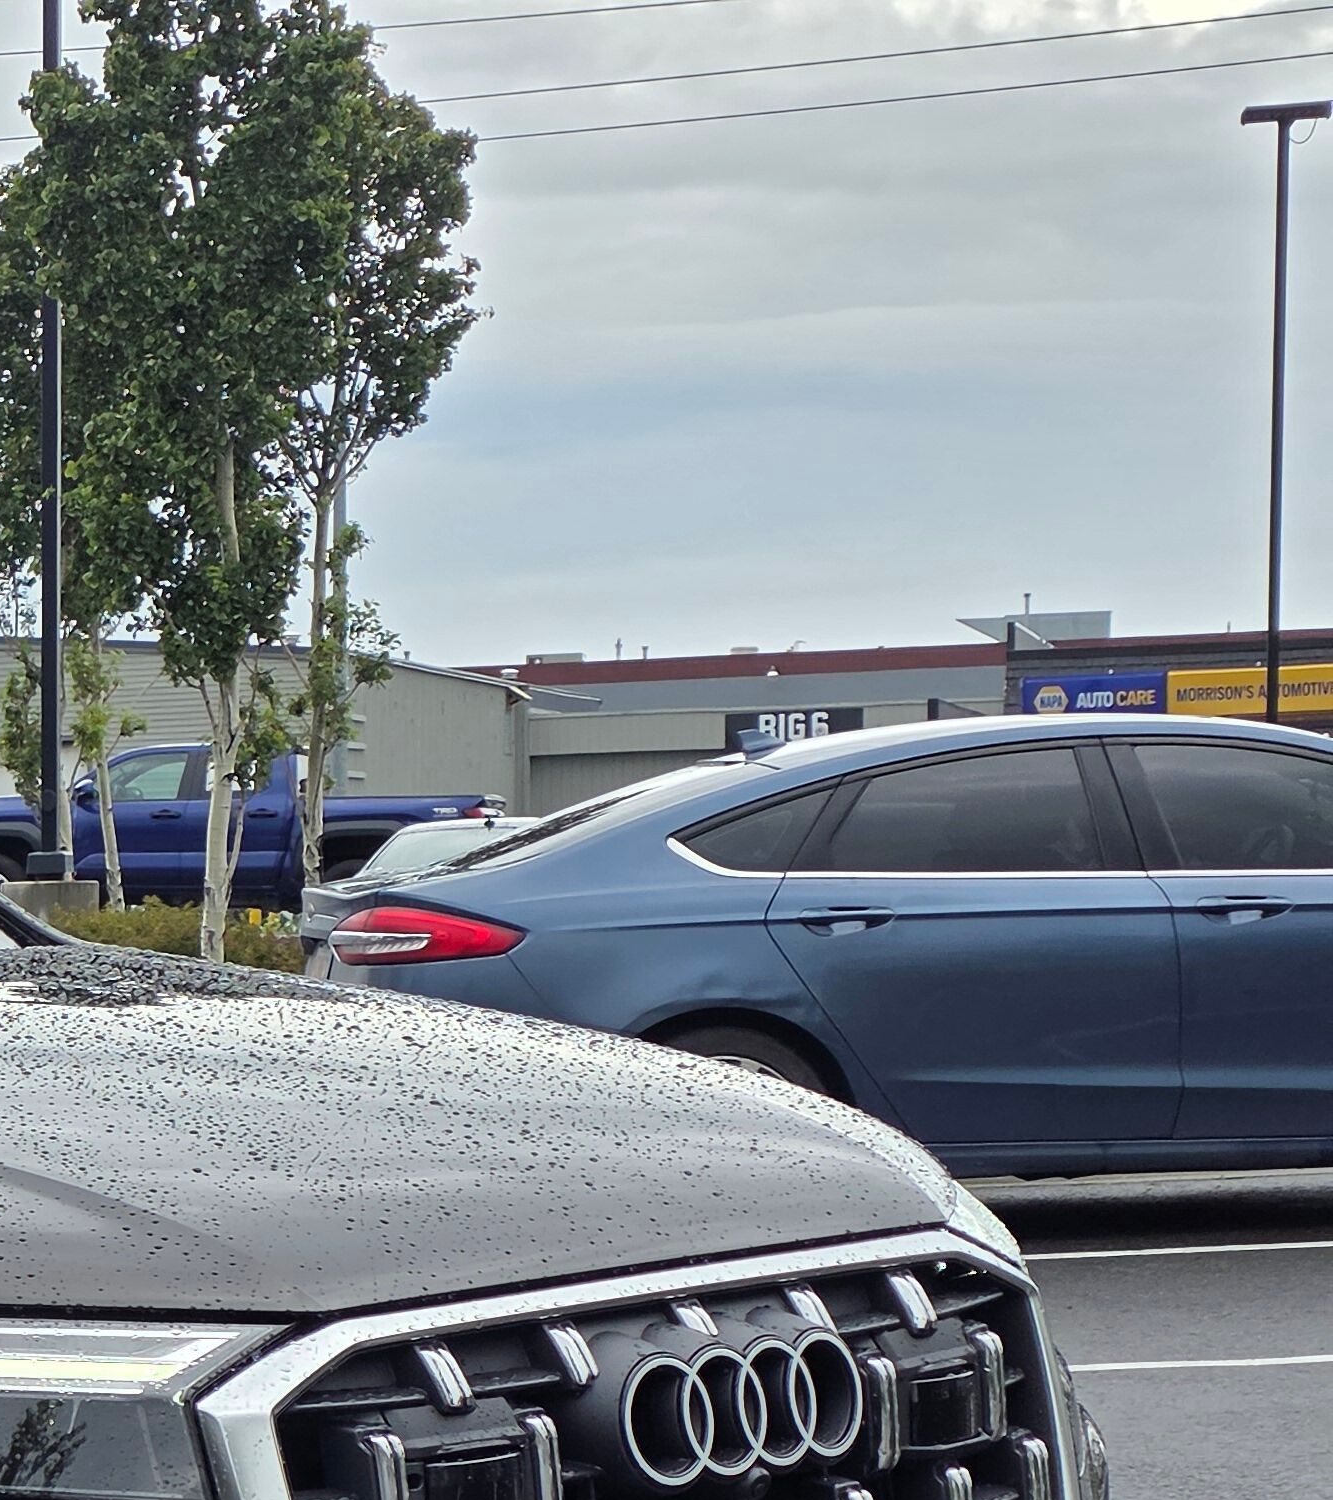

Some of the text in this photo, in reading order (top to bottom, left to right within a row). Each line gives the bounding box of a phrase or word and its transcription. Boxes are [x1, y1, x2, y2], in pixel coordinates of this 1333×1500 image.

[1076, 690, 1114, 709] AUTO
[1116, 689, 1157, 707] CARE
[1177, 681, 1333, 702] MORRISON'S ATOMOTIVE
[811, 710, 829, 738] 6
